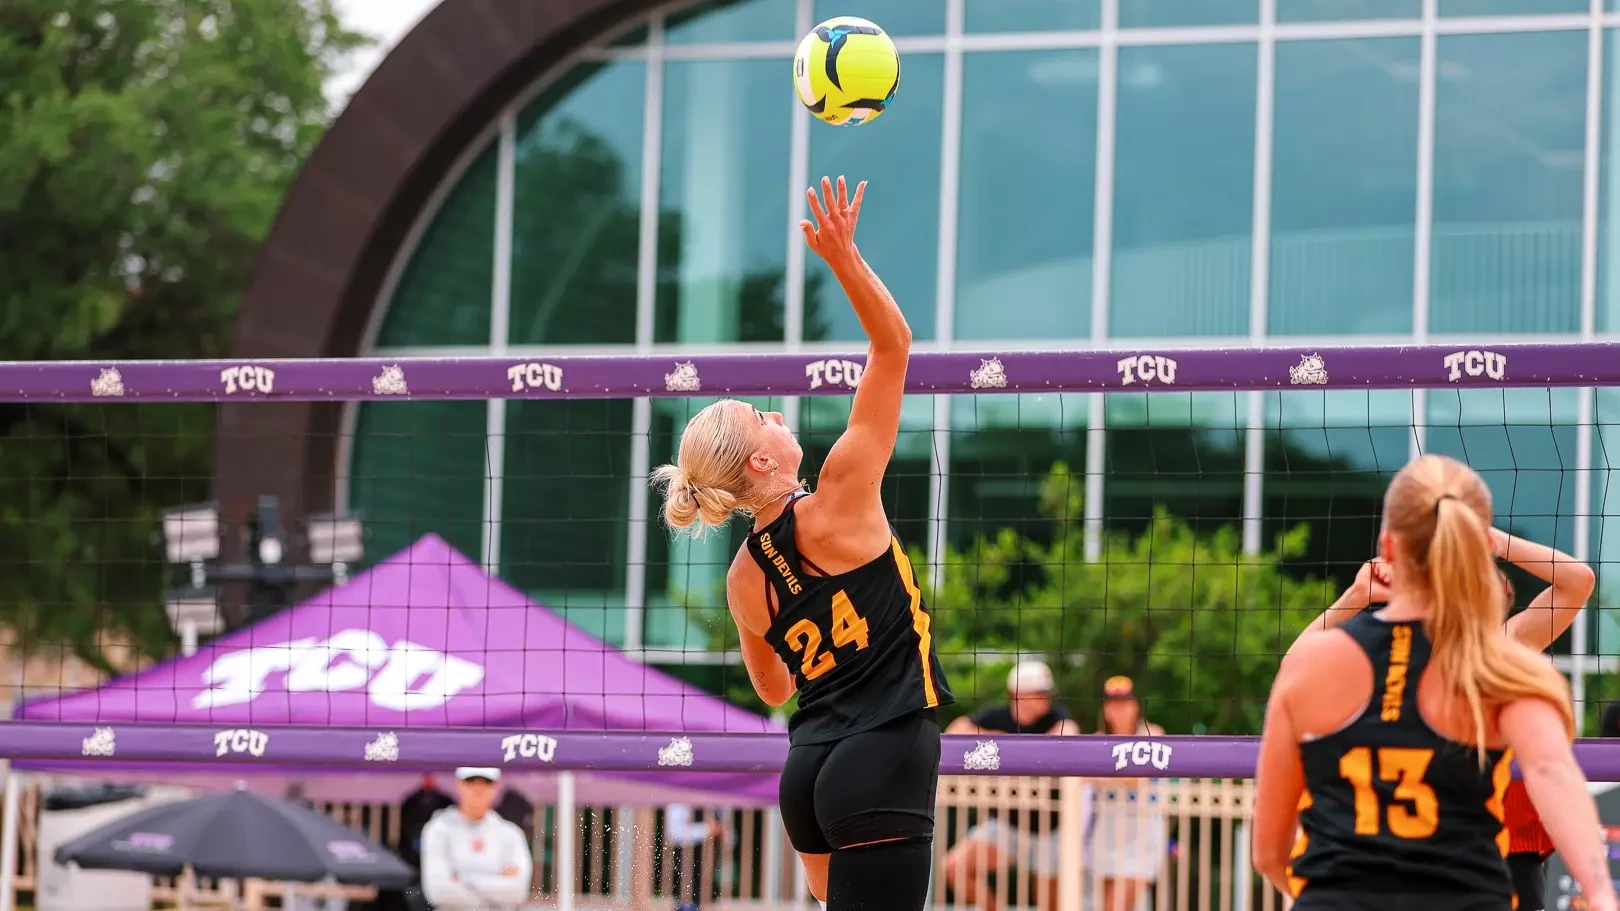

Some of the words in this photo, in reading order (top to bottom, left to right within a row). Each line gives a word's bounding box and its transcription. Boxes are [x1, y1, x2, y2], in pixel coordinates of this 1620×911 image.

[220, 365, 275, 395] TCU
[507, 362, 563, 393] TCU
[805, 358, 863, 390] TCU
[1117, 355, 1177, 386] TCU
[1443, 350, 1507, 382] TCU
[760, 532, 778, 559] SUN
[772, 554, 803, 595] DEVILS
[784, 589, 869, 681] 24
[191, 628, 485, 711] TCU
[213, 728, 269, 758] TCU
[500, 733, 558, 763] TCU
[1111, 740, 1172, 771] TCU
[1338, 747, 1440, 839] 13
